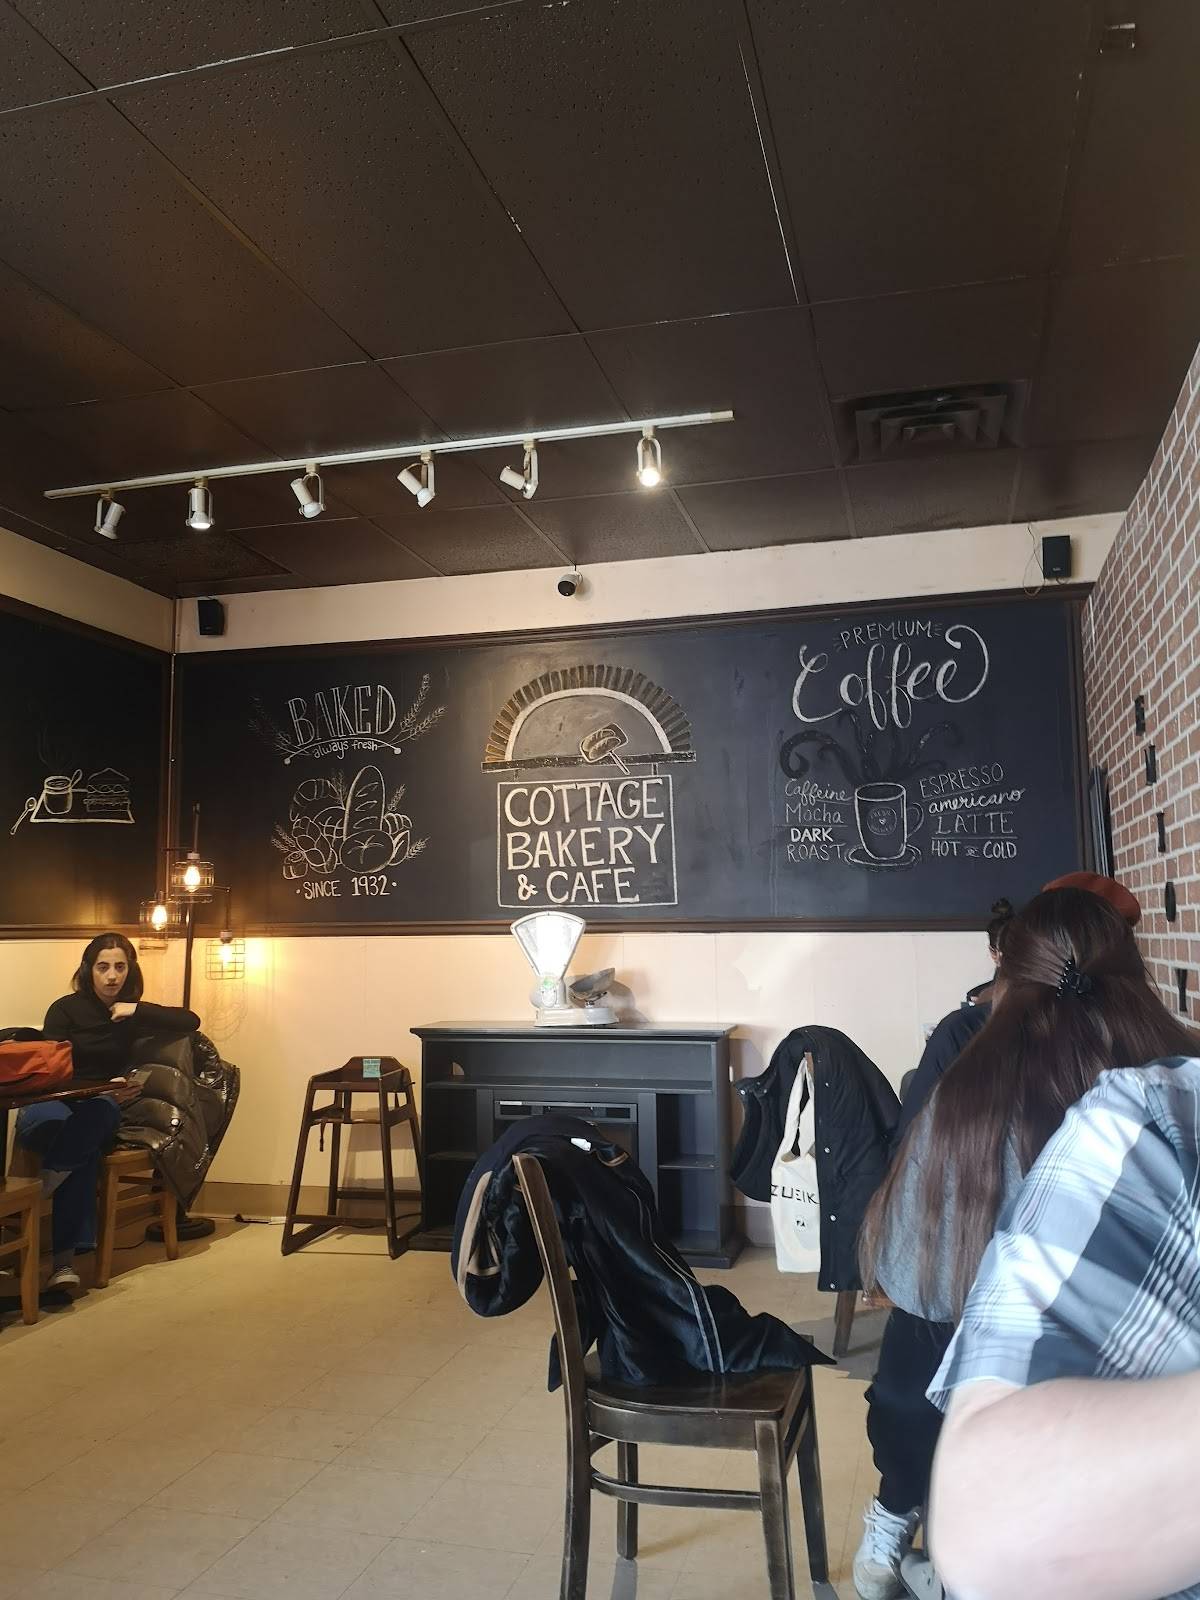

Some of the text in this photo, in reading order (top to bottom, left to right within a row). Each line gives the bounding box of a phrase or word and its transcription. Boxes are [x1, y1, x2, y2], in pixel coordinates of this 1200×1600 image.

[840, 620, 933, 649] PREMIUM
[793, 624, 989, 731] Coffee
[286, 684, 397, 747] BAKED
[314, 740, 378, 760] always fresh
[784, 778, 854, 807] Caffeine
[920, 763, 1004, 798] ESPRESSO
[504, 777, 665, 828] COTTAGE
[785, 802, 845, 824] Mocha
[928, 787, 1027, 814] americano
[790, 827, 834, 842] DARK
[935, 811, 1014, 835] LATTE
[506, 823, 666, 871] BAKERY
[786, 842, 847, 863] ROAST
[931, 840, 960, 856] HOT
[982, 840, 1017, 859] COLD
[302, 875, 391, 900] SINCE 1932
[517, 867, 640, 904] & CAFE
